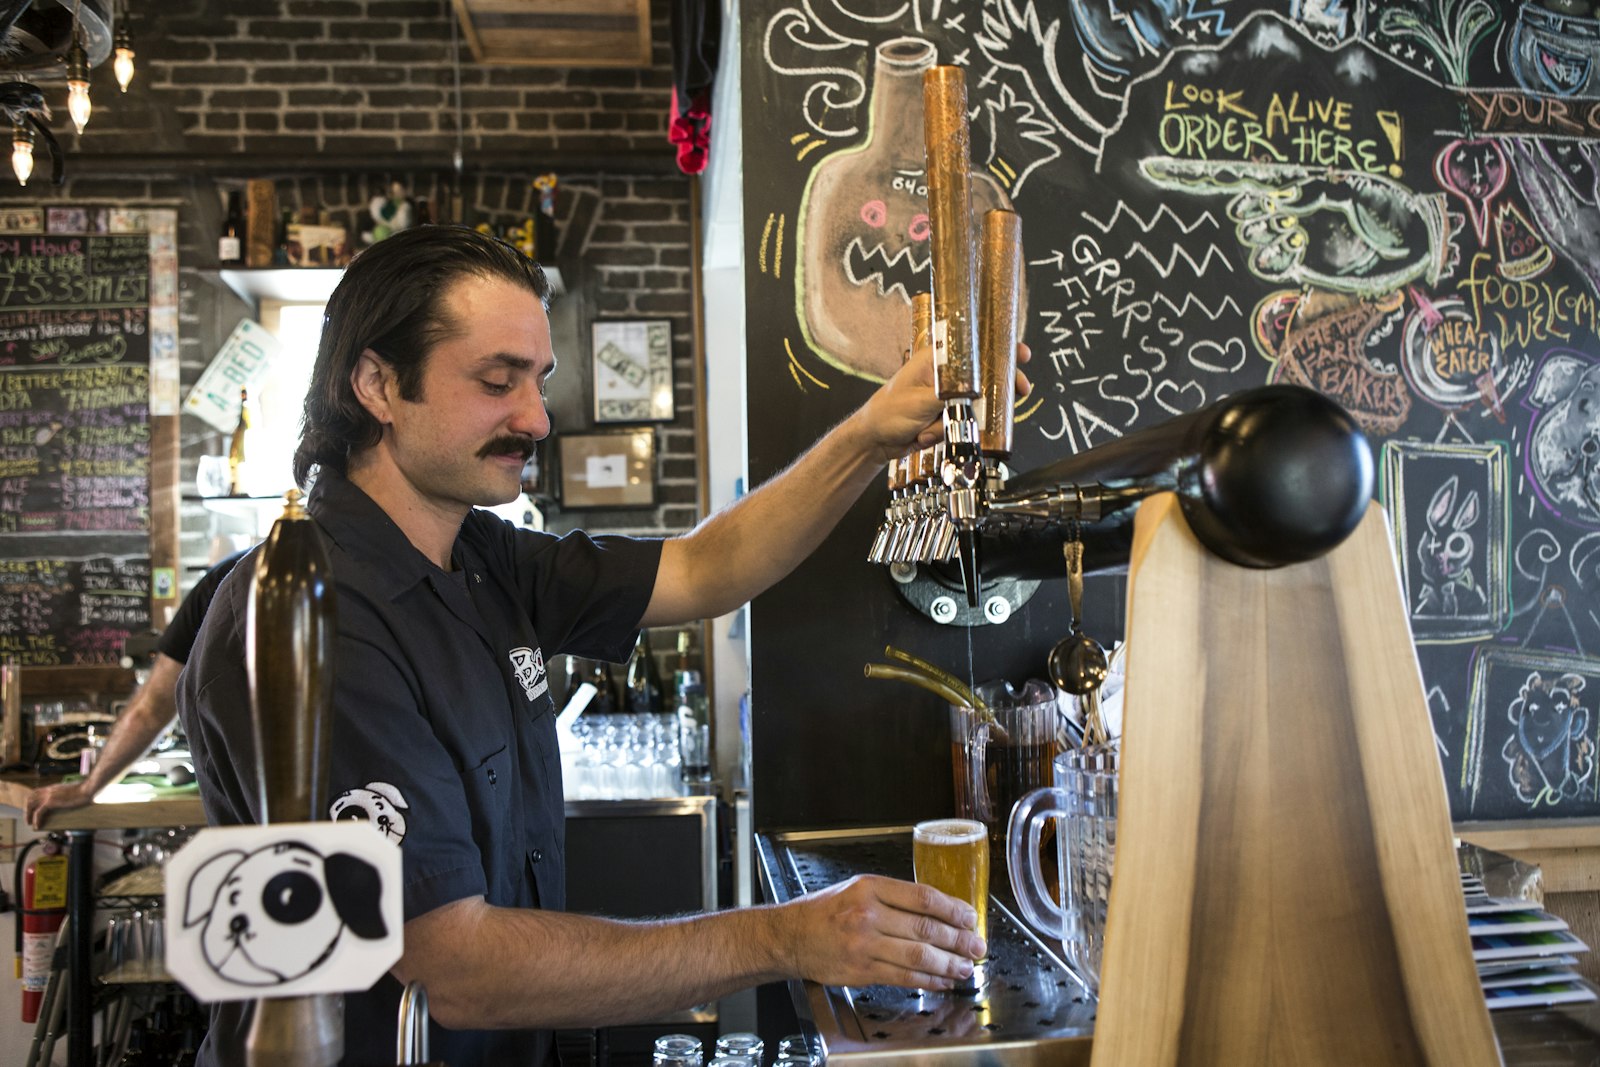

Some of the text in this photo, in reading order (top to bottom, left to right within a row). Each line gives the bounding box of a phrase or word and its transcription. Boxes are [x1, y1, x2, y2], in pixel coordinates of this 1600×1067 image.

[1266, 91, 1353, 139] ALIVE
[1468, 91, 1585, 131] YOUR
[1159, 113, 1289, 161] ORDER
[1493, 281, 1600, 350] WELCOM
[1295, 323, 1334, 355] THE
[1425, 320, 1489, 356] WHEAT
[1435, 347, 1490, 379] EATER
[26, 634, 57, 650] THE
